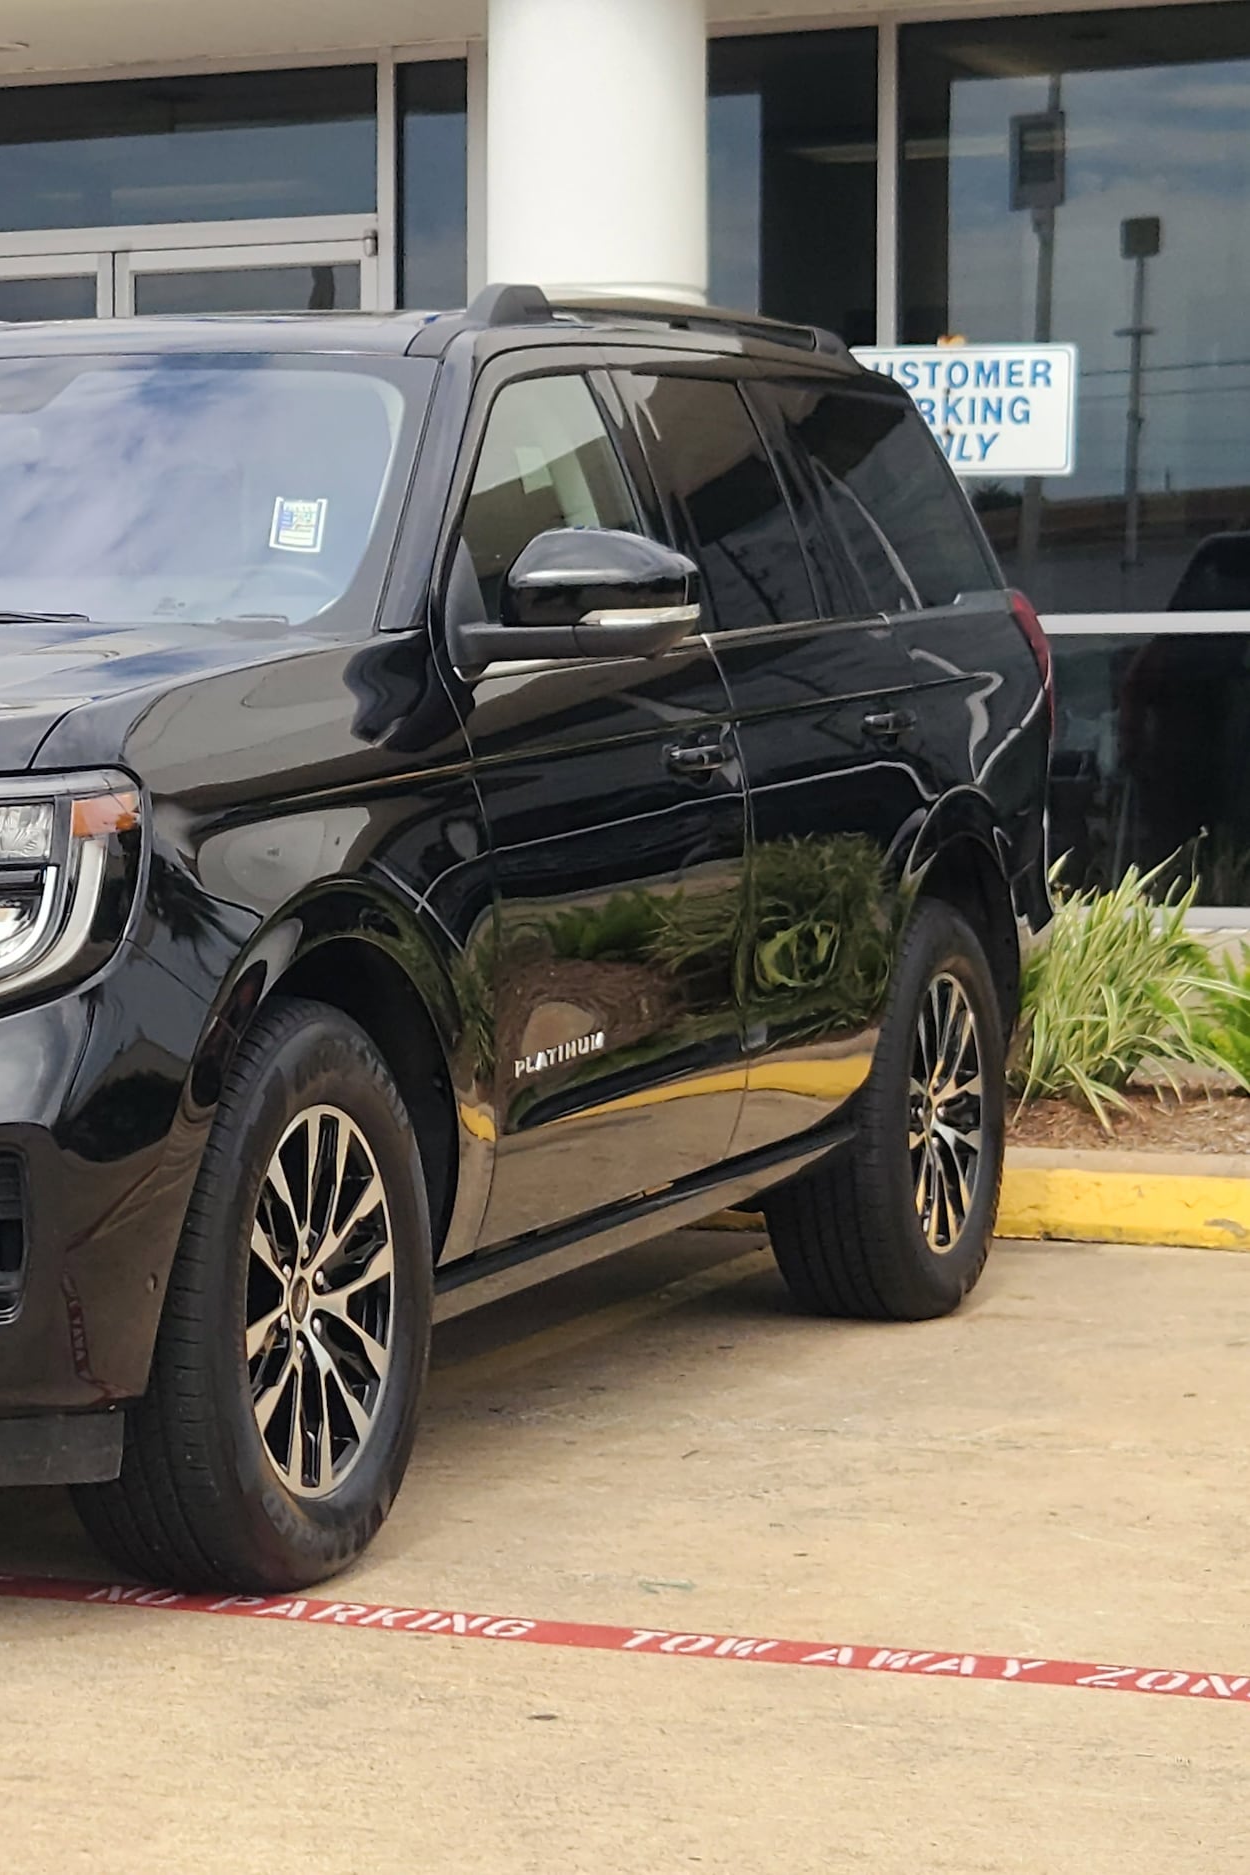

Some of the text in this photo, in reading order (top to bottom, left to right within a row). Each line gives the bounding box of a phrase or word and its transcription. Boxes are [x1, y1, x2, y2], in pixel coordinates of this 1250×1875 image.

[873, 360, 1052, 389] STOMER
[916, 396, 1031, 425] RKING
[934, 432, 999, 462] NLY
[514, 1031, 605, 1079] PLATINUM
[206, 1594, 537, 1639] PARKING
[622, 1629, 780, 1657] TOW
[800, 1646, 1048, 1678] AWAY
[1076, 1665, 1250, 1697] ZON
